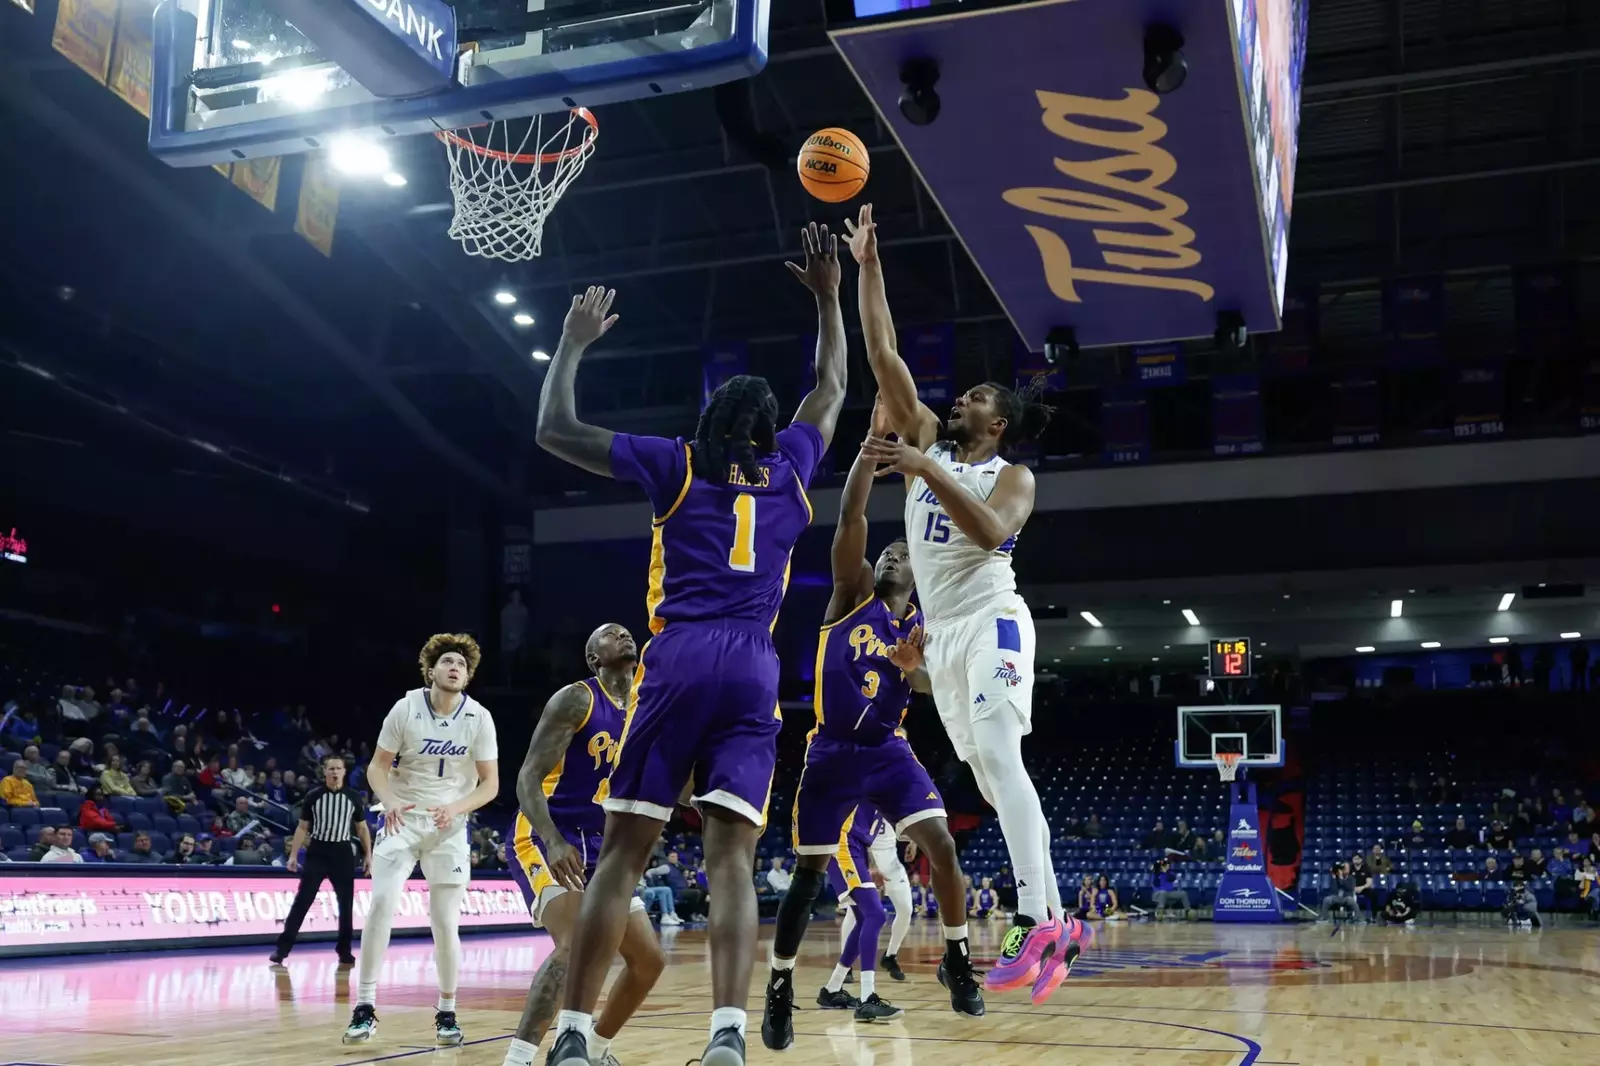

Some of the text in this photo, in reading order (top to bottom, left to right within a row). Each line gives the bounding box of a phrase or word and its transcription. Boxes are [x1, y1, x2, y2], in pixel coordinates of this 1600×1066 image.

[805, 158, 838, 175] NCAA
[1002, 87, 1214, 302] Tulsa
[728, 463, 770, 488] HAES
[728, 492, 756, 573] 1
[923, 511, 951, 544] 15
[1216, 641, 1247, 654] 11:15
[992, 666, 1022, 683] Tulsa
[1225, 653, 1242, 675] 12
[861, 670, 880, 700] 3
[418, 738, 468, 756] Tulsa
[438, 758, 445, 777] 1
[1231, 846, 1258, 857] Tulsa
[143, 891, 230, 924] YOUR
[233, 890, 314, 922] HOM
[398, 890, 426, 916] OR
